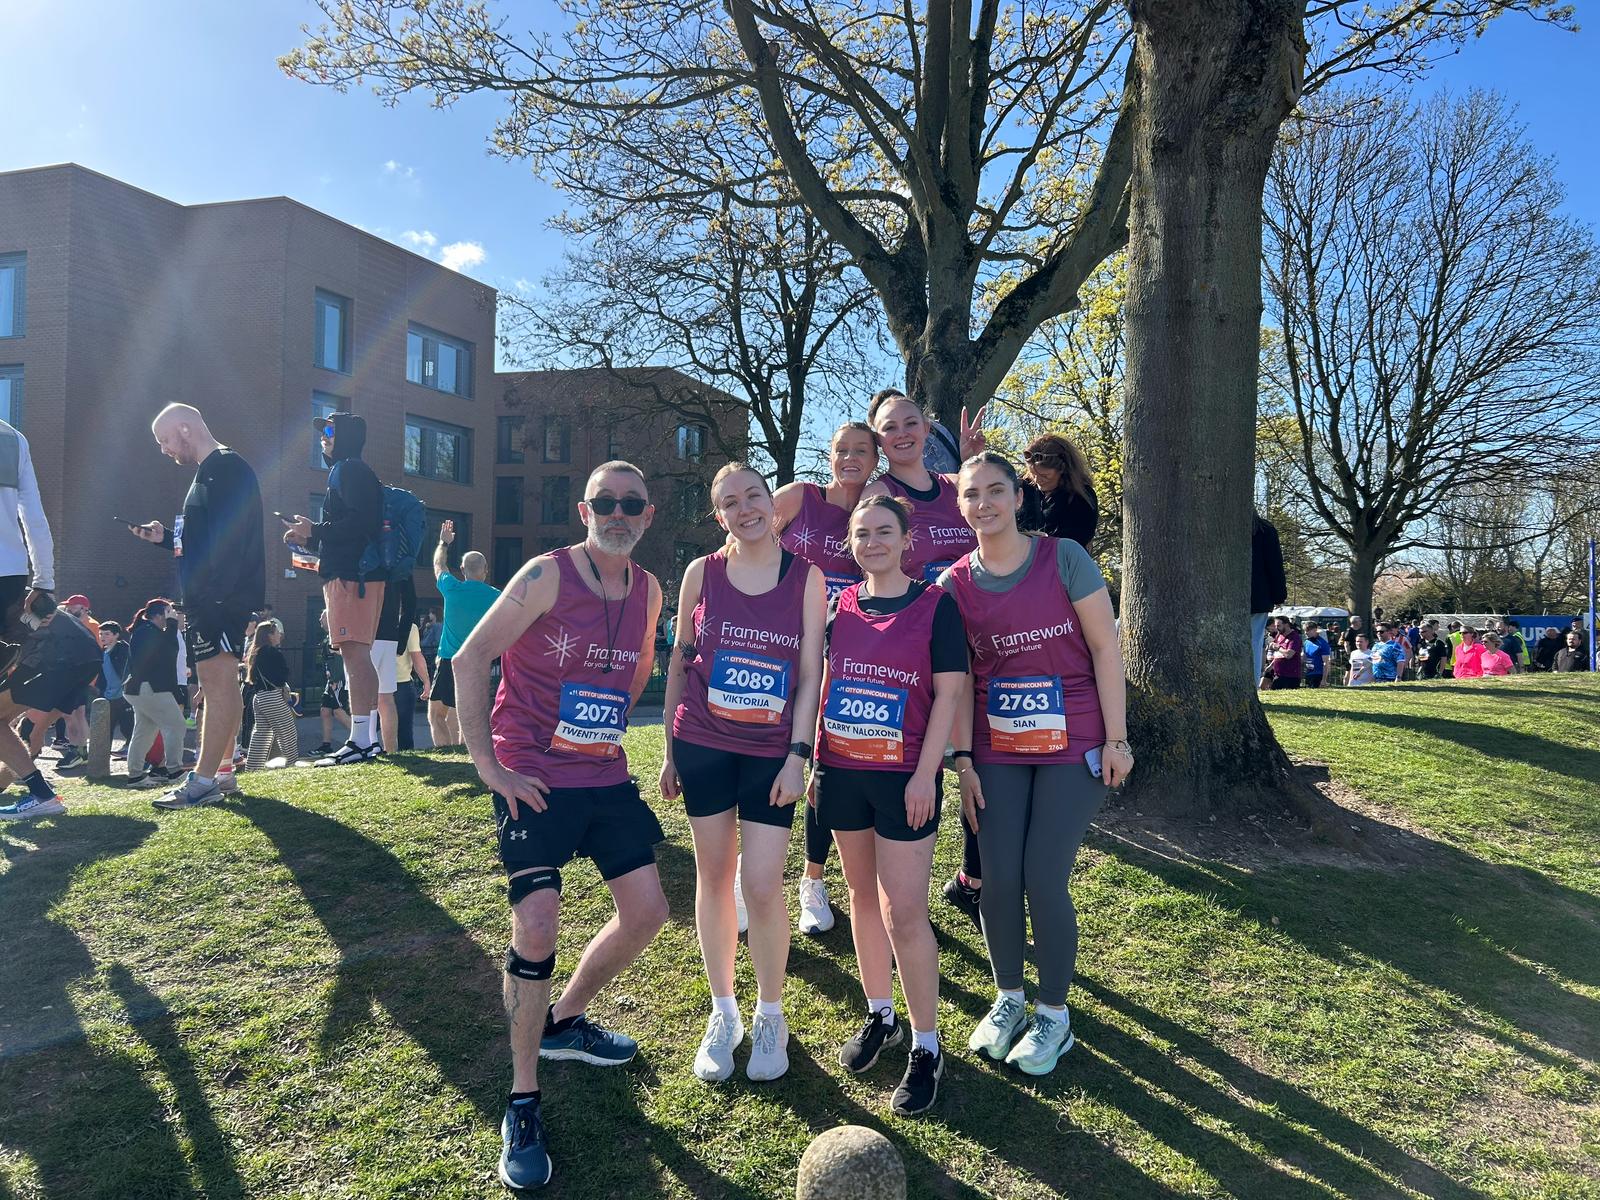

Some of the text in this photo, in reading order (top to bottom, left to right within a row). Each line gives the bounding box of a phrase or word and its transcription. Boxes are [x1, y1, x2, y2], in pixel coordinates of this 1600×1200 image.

[721, 621, 800, 650] Framework
[991, 618, 1074, 650] Framework
[730, 640, 746, 648] your
[746, 641, 767, 651] future
[1004, 647, 1020, 657] your
[1020, 643, 1042, 652] future
[609, 663, 625, 671] futur
[749, 659, 771, 669] LINCOLN
[724, 667, 775, 691] 2089
[842, 657, 920, 687] Framework
[866, 676, 885, 685] future
[597, 692, 617, 700] LINCOLN
[722, 693, 770, 707] VIKTORIJA
[863, 688, 887, 699] LINCOLN
[998, 693, 1050, 711] 2763
[574, 702, 618, 725] 2075
[838, 698, 890, 722] 2086
[827, 721, 899, 738] CARRY NALOXONE
[1013, 719, 1036, 728] SIAN
[562, 726, 620, 741] TWENTY THREE
